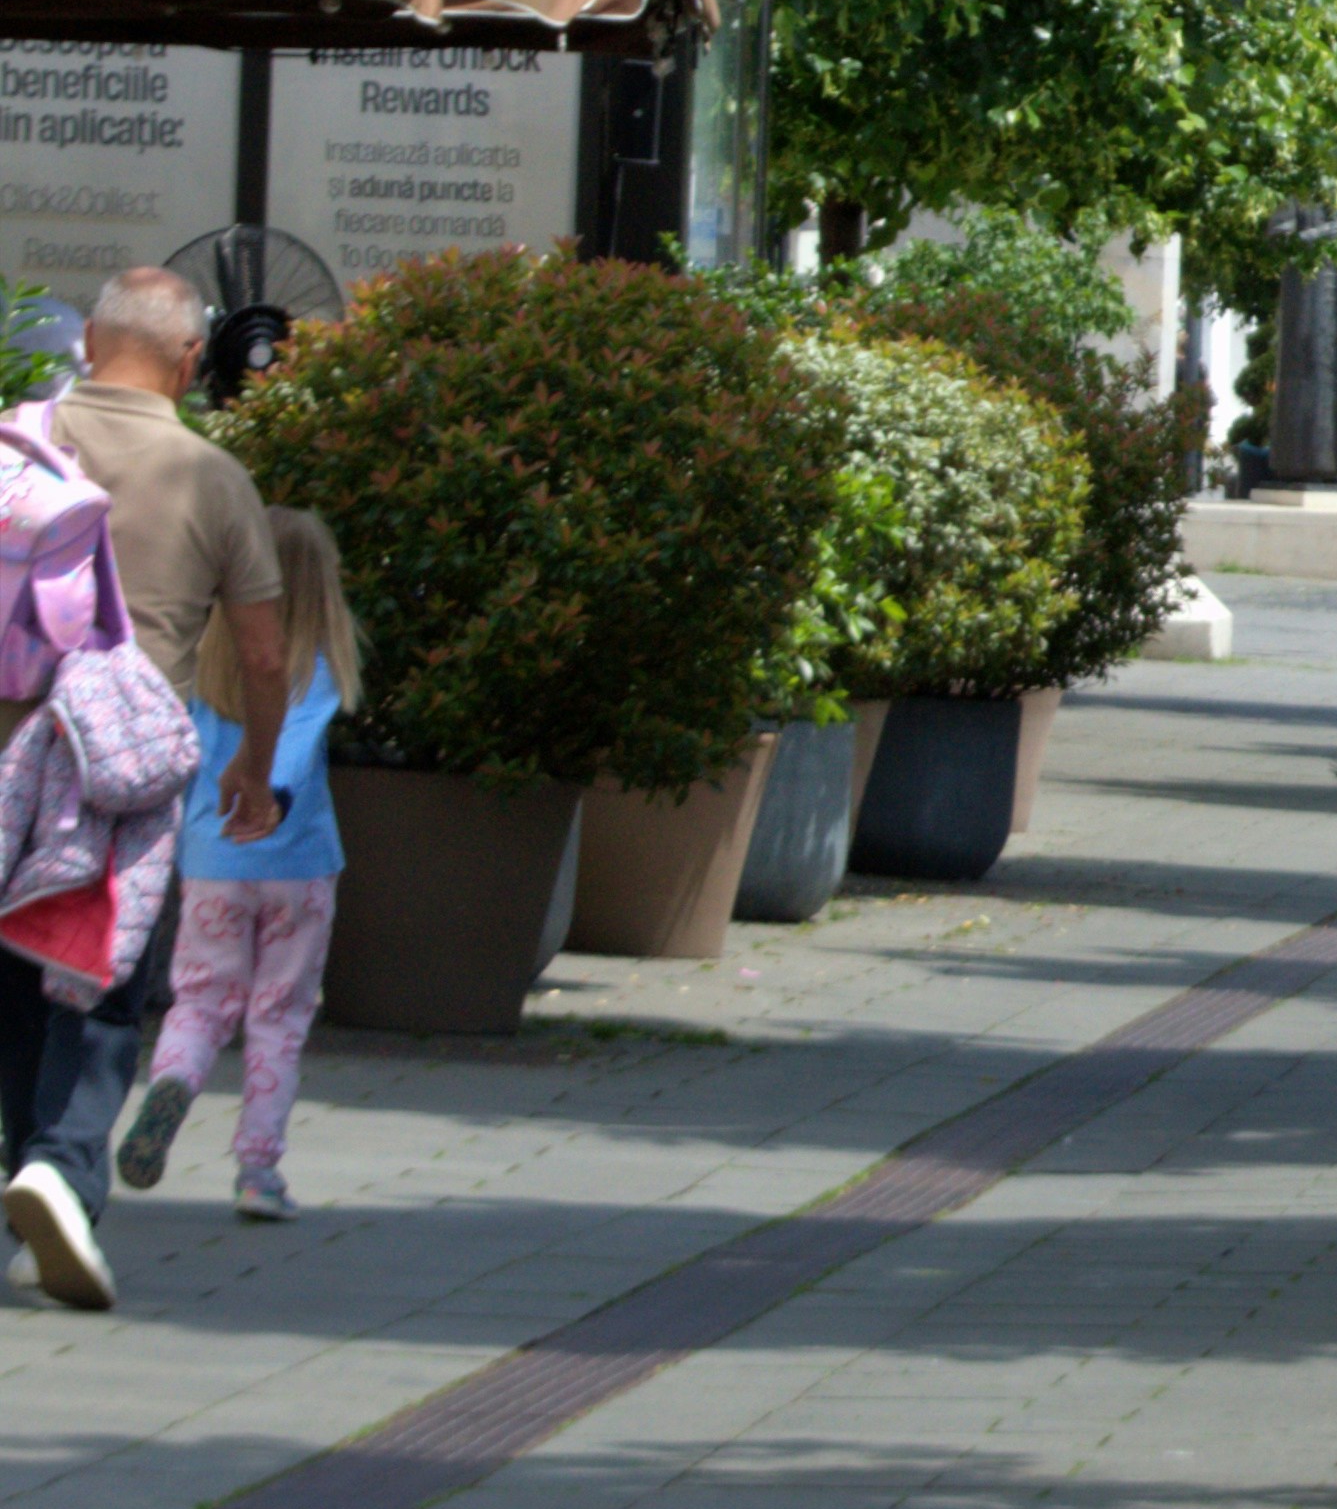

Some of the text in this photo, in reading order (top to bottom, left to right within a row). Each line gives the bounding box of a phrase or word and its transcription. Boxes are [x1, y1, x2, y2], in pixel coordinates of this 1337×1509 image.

[308, 48, 402, 68] nstall
[1, 60, 169, 103] beneficiile
[361, 79, 491, 117] Rewards
[0, 105, 185, 155] in aplicație:
[349, 174, 415, 200] adună
[418, 178, 492, 203] puncte
[497, 177, 516, 204] la
[334, 207, 506, 239] fiecare comandă
[338, 243, 362, 269] To
[365, 244, 393, 270] Go
